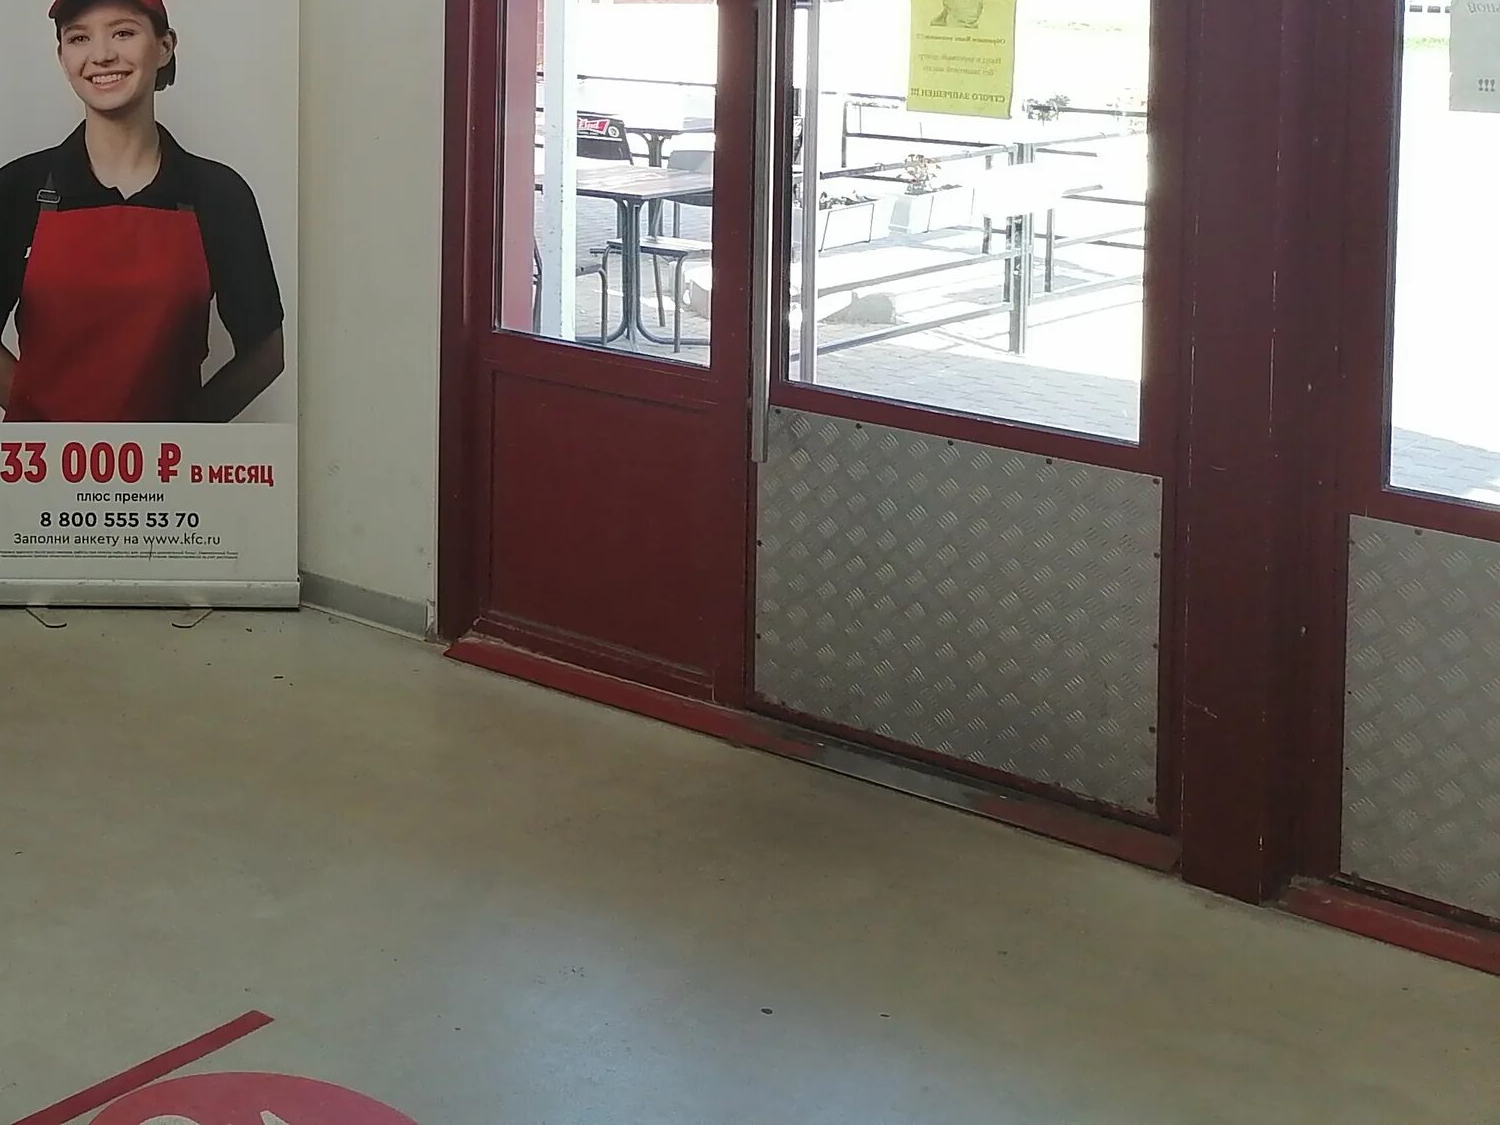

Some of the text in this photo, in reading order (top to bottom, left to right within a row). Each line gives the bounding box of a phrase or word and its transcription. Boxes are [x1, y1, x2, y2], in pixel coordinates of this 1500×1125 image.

[0, 442, 47, 484] 33
[61, 442, 144, 484] 000
[158, 443, 182, 484] ₽
[191, 465, 204, 483] В
[208, 465, 275, 487] МЕСЯЦ
[77, 491, 165, 505] плюс премии
[40, 512, 200, 528] 8 800 555 53 70
[13, 533, 221, 548] Заполни анкету на www.kfc.ru
